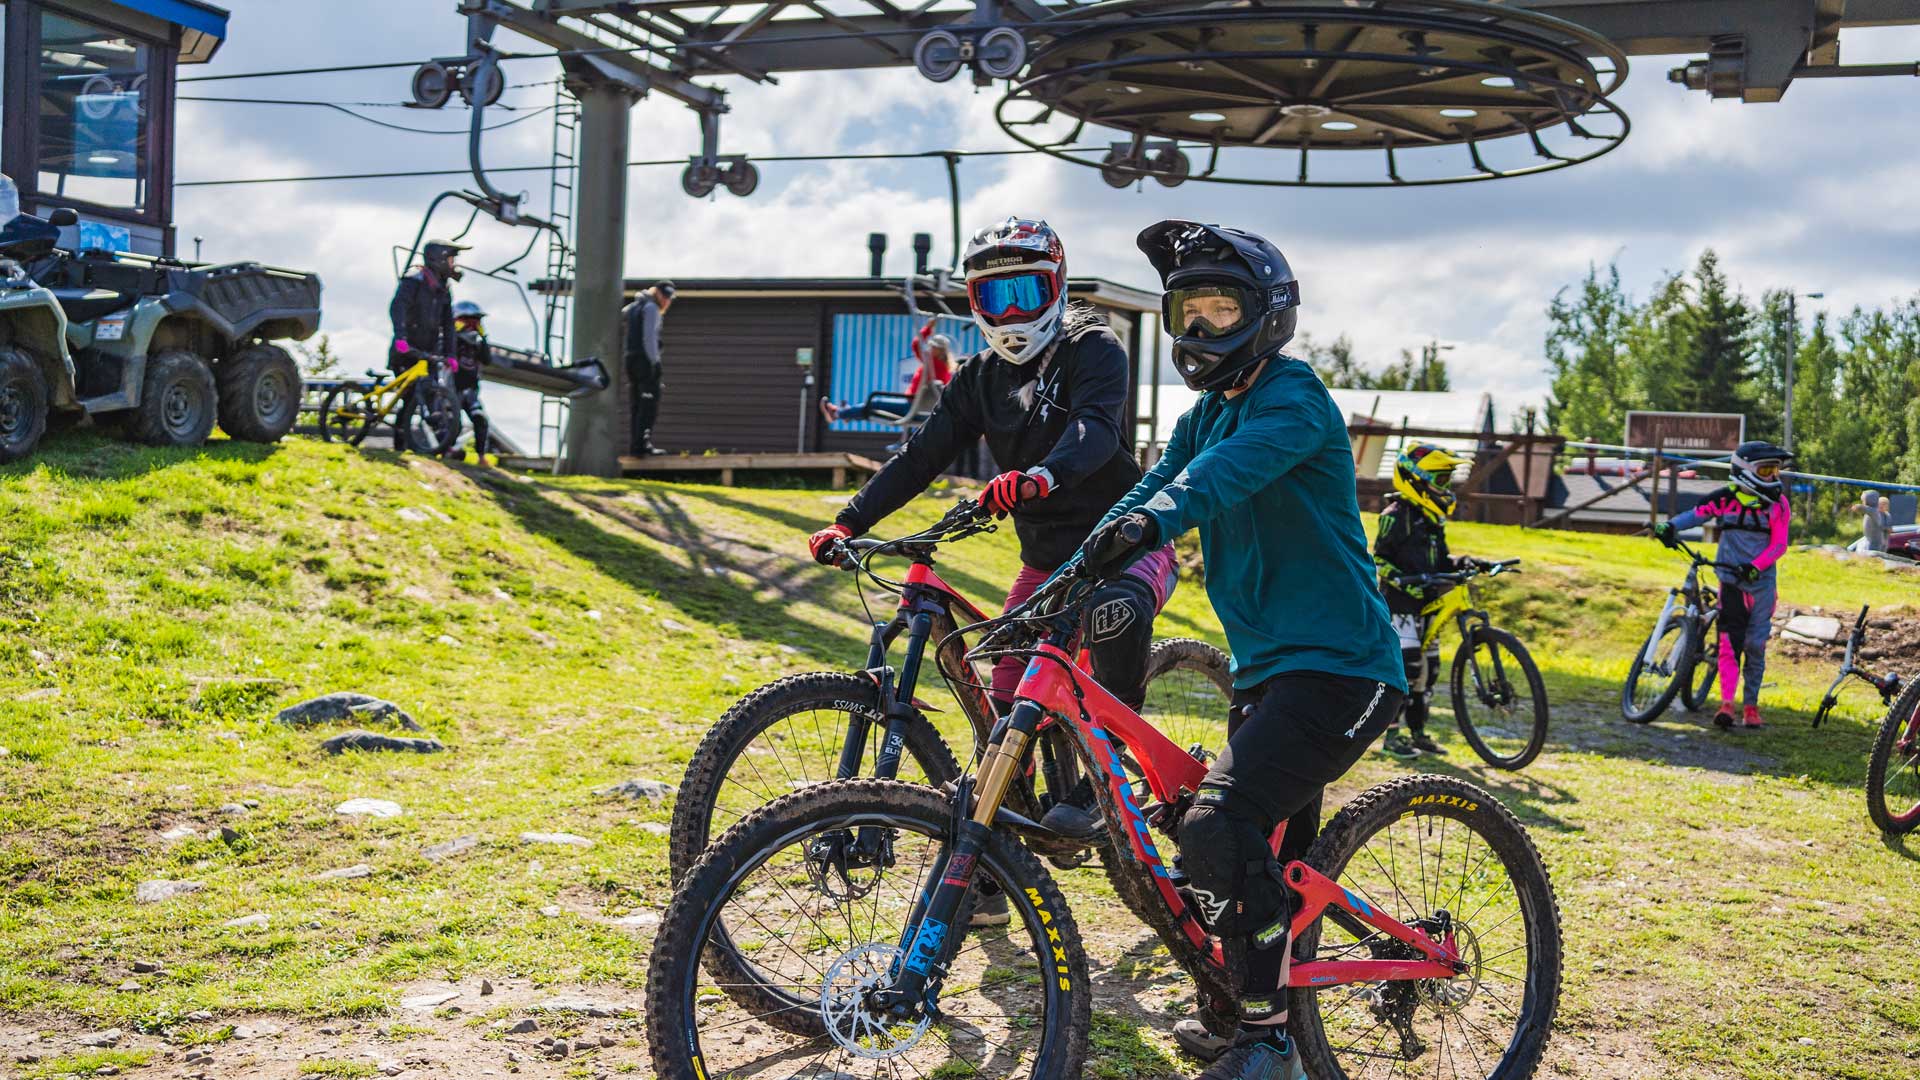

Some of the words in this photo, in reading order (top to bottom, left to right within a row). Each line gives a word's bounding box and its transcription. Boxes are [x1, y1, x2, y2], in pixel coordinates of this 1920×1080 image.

[832, 700, 866, 713] SWISS
[1408, 794, 1479, 811] MAXXIS
[906, 919, 943, 973] FOX
[1024, 887, 1071, 991] MAXXIS
